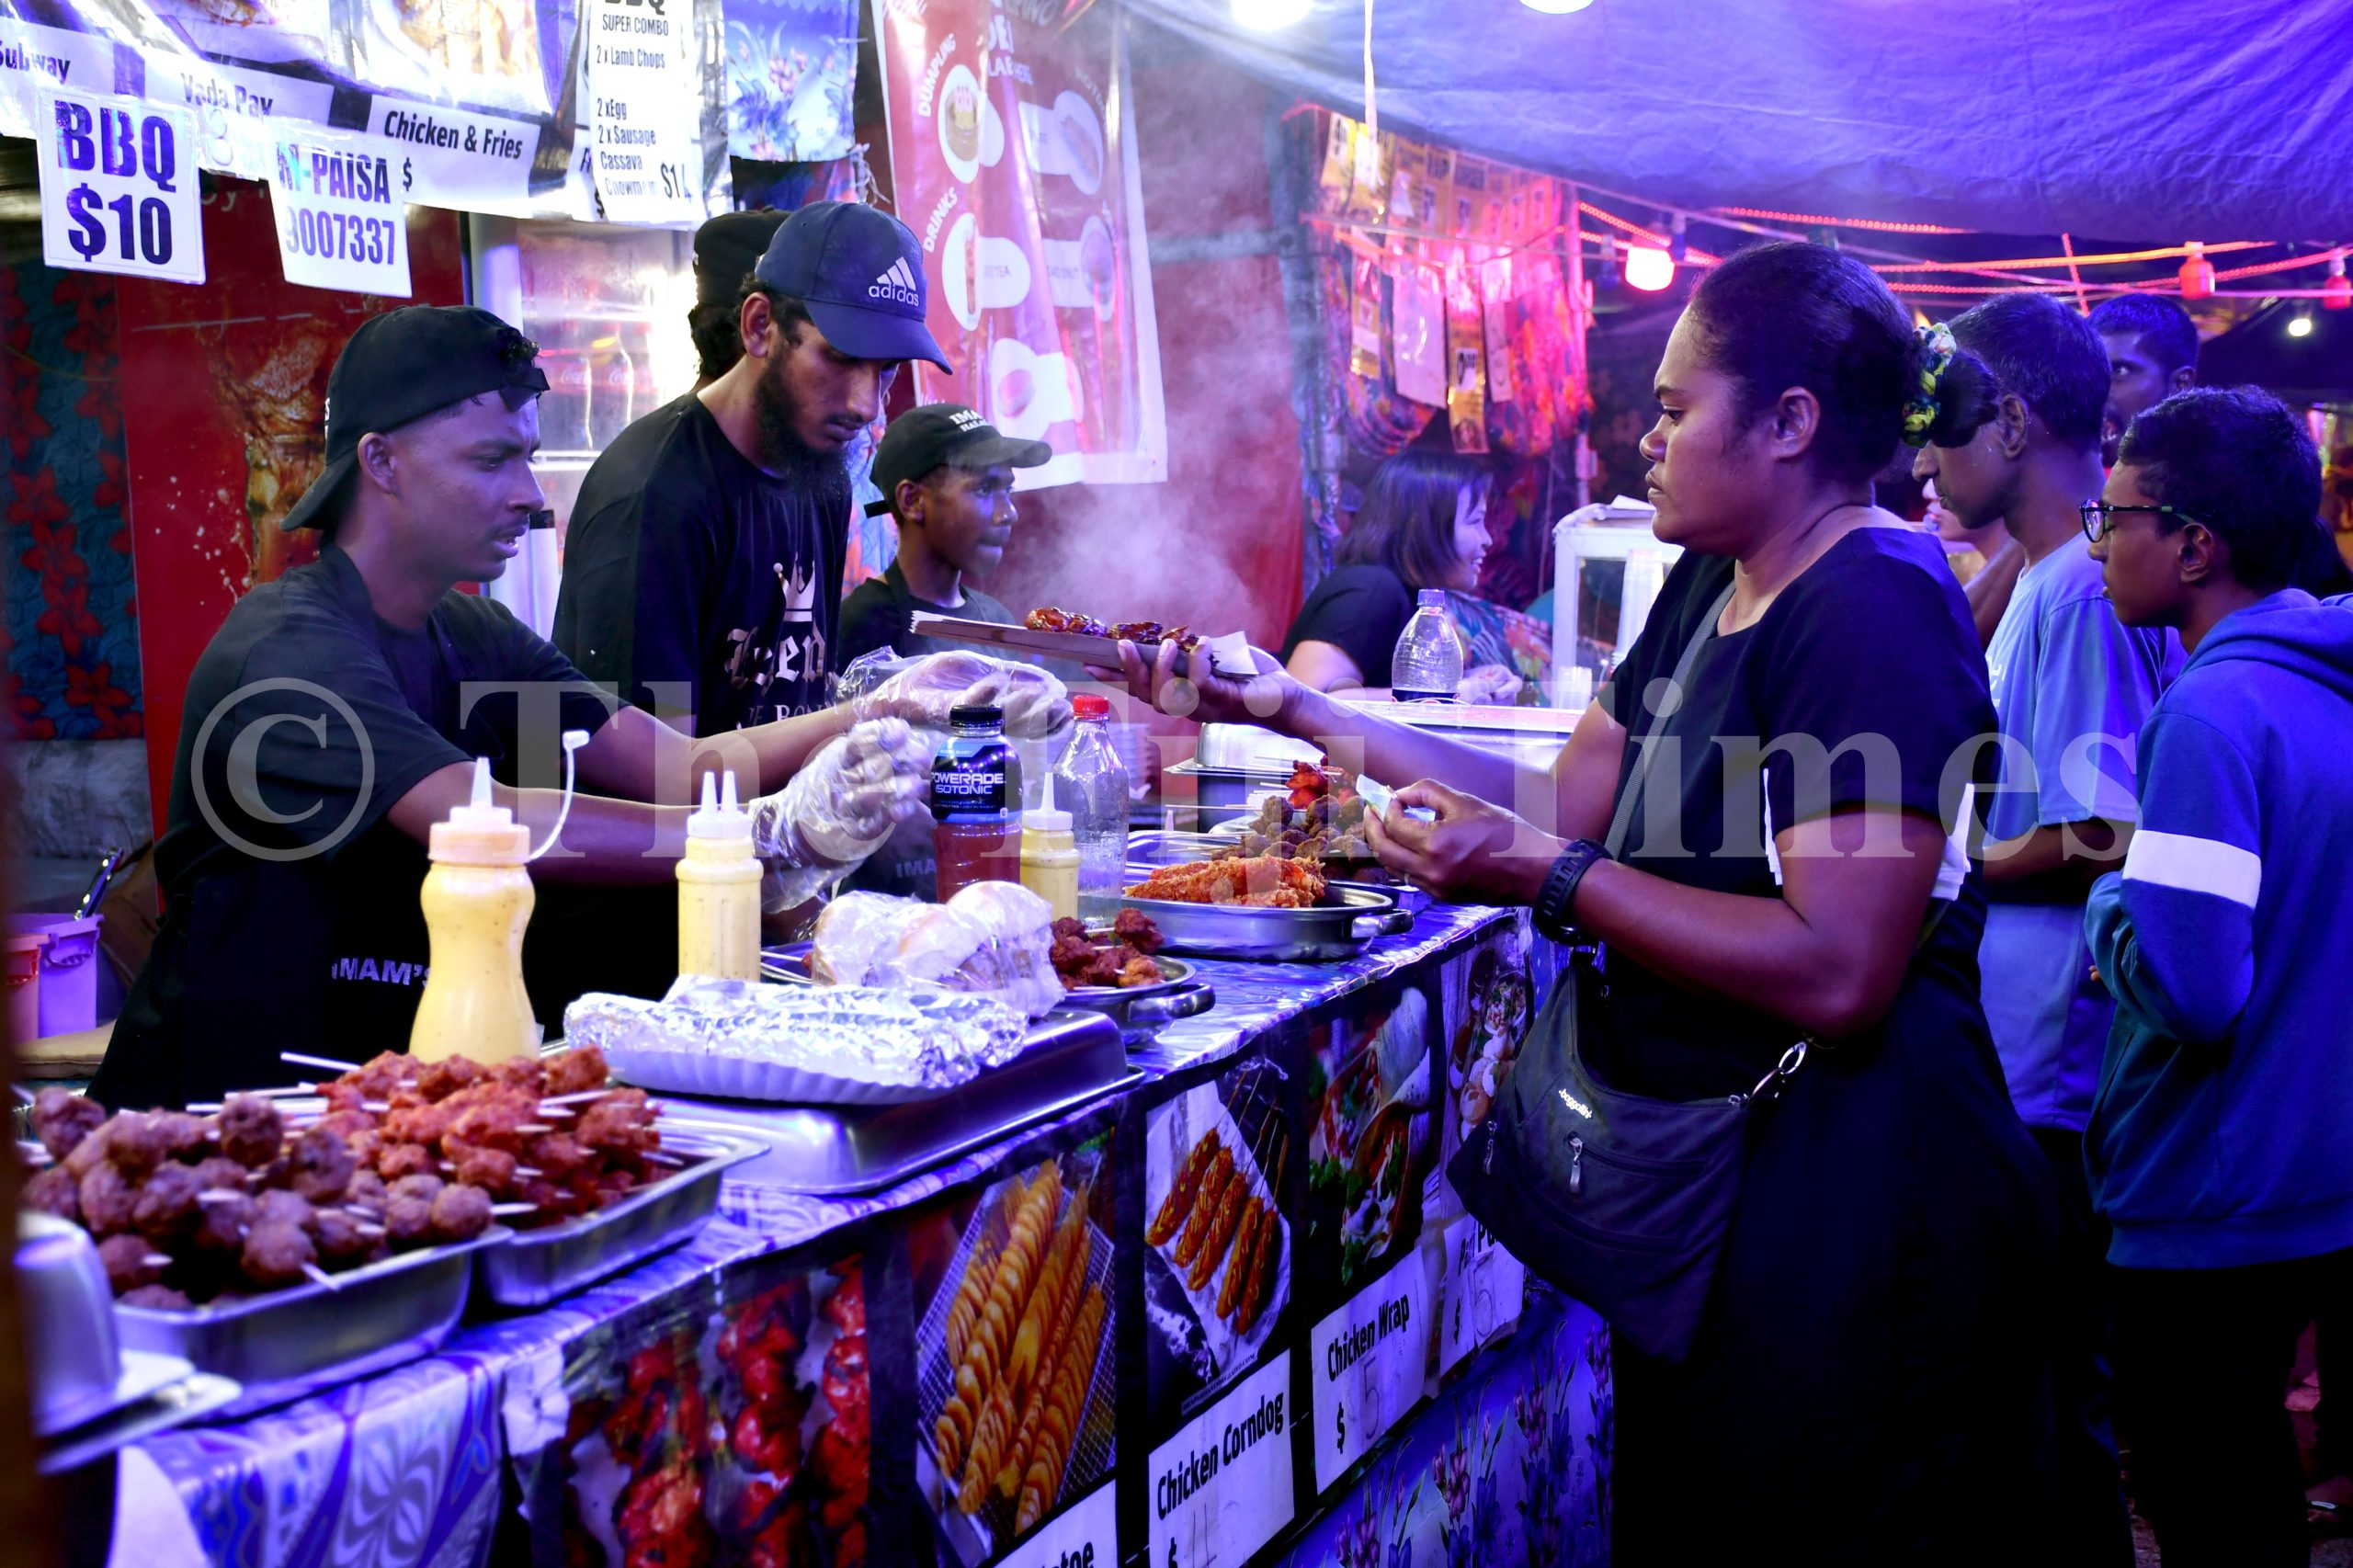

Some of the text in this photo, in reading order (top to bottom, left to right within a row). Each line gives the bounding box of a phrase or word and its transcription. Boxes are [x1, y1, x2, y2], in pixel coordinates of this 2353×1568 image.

[603, 14, 669, 36] SUPER COMBO
[597, 44, 602, 64] 2
[611, 46, 634, 66] Lamb
[637, 48, 665, 69] Chops
[597, 97, 603, 118] 2
[55, 100, 176, 192] BBQ
[384, 110, 523, 159] Chicken & Fries
[598, 124, 604, 144] 2
[614, 125, 656, 147] Sausage
[403, 156, 413, 192] $
[600, 151, 642, 170] Cassava
[67, 183, 173, 265] $10
[923, 187, 958, 254] DRINKS
[869, 283, 919, 307] adidas
[936, 784, 993, 795] ISOTONIC
[1327, 1294, 1410, 1382] Chicken Wrap
[1337, 1402, 1346, 1455] $
[1157, 1392, 1284, 1521] Chicken Corndog
